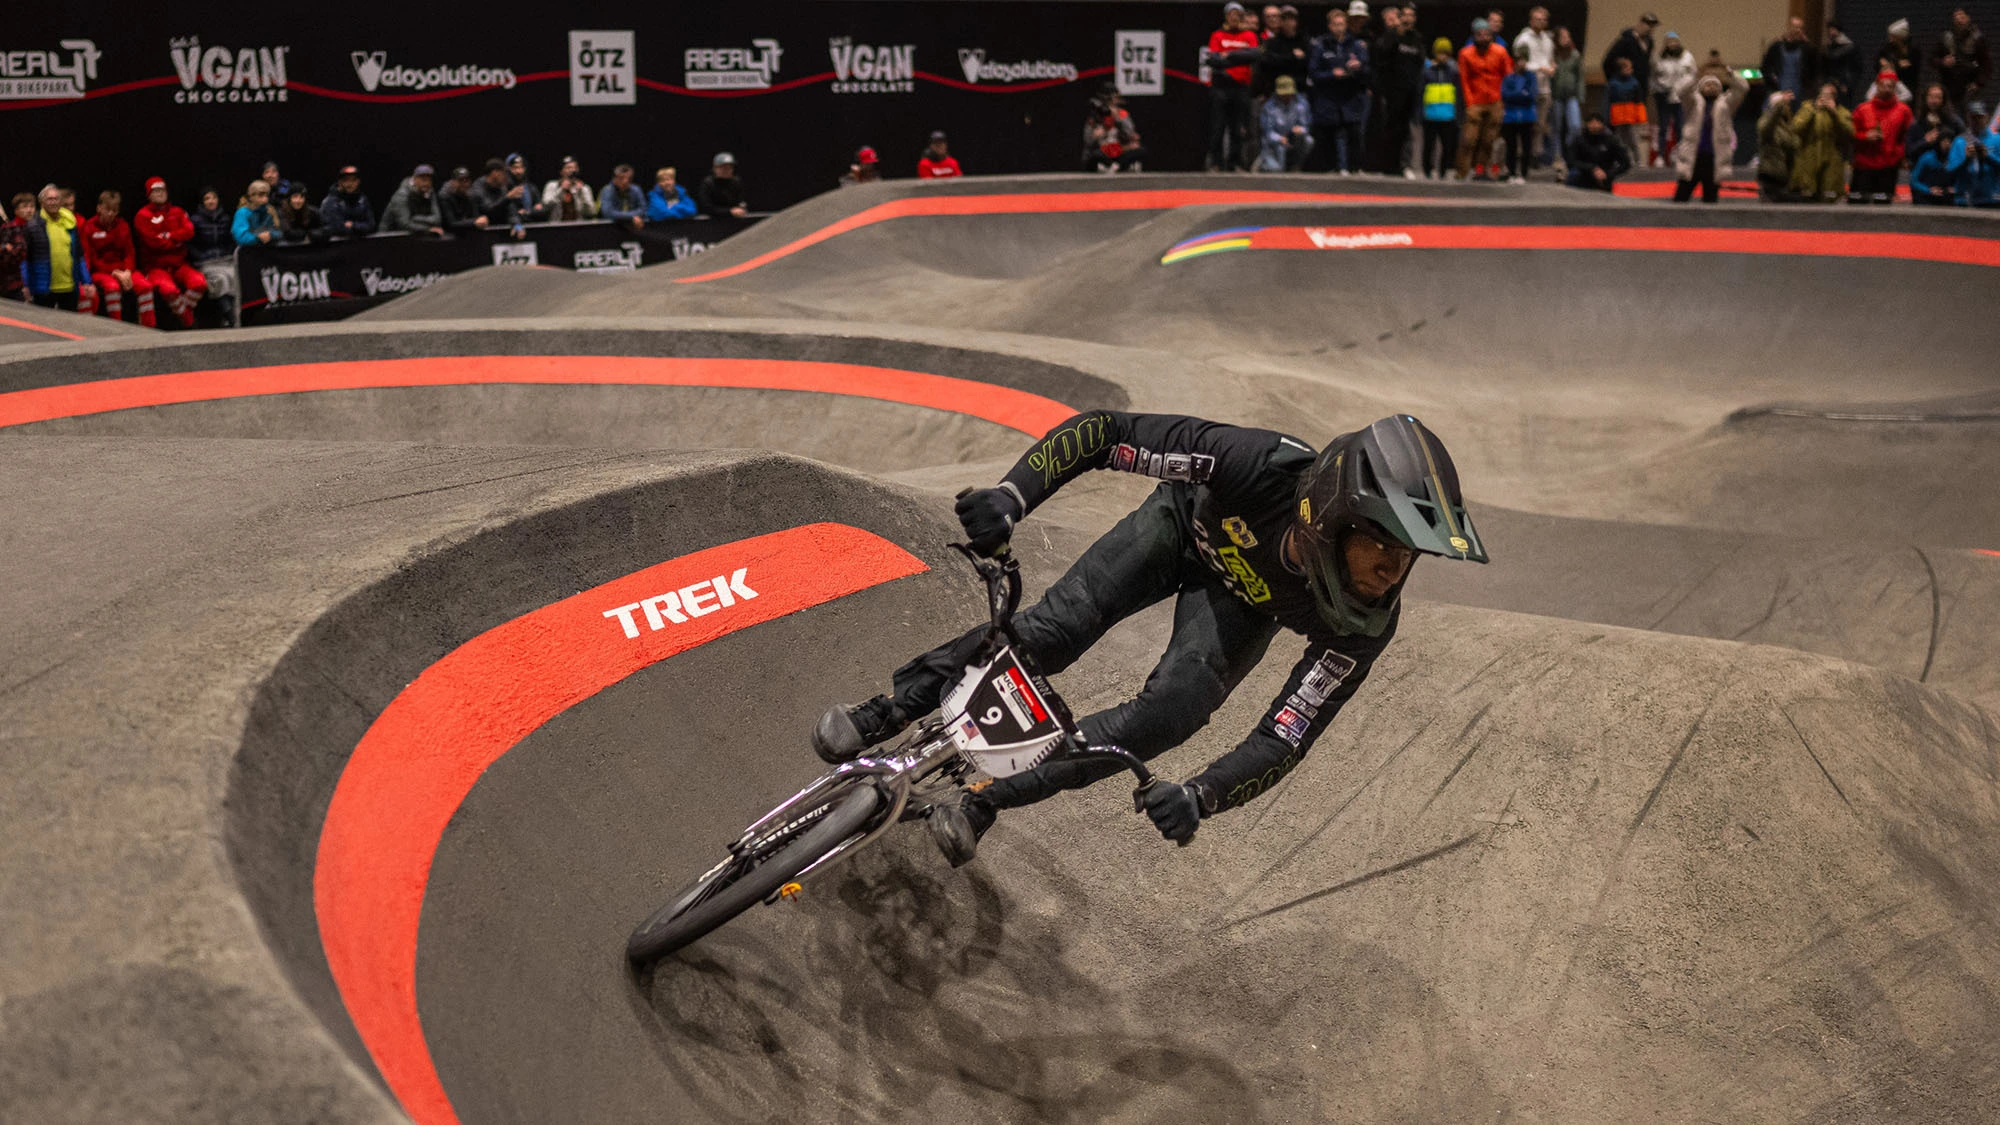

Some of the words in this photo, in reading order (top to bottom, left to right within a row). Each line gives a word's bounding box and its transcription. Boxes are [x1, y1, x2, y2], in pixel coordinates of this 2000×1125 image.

[170, 46, 287, 89] VGAN
[578, 40, 626, 68] ÖTZ
[829, 44, 914, 81] VGAN
[957, 48, 1079, 84] Velosolutions
[351, 51, 517, 92] Velosolutions
[578, 73, 626, 93] TAL
[1121, 67, 1157, 85] TAL
[174, 90, 289, 104] CHOCOLATE
[831, 81, 914, 94] CHOCOLATE
[261, 269, 331, 303] VGAN
[602, 567, 760, 639] TREK
[1003, 675, 1015, 691] UCI
[978, 706, 1004, 726] 9
